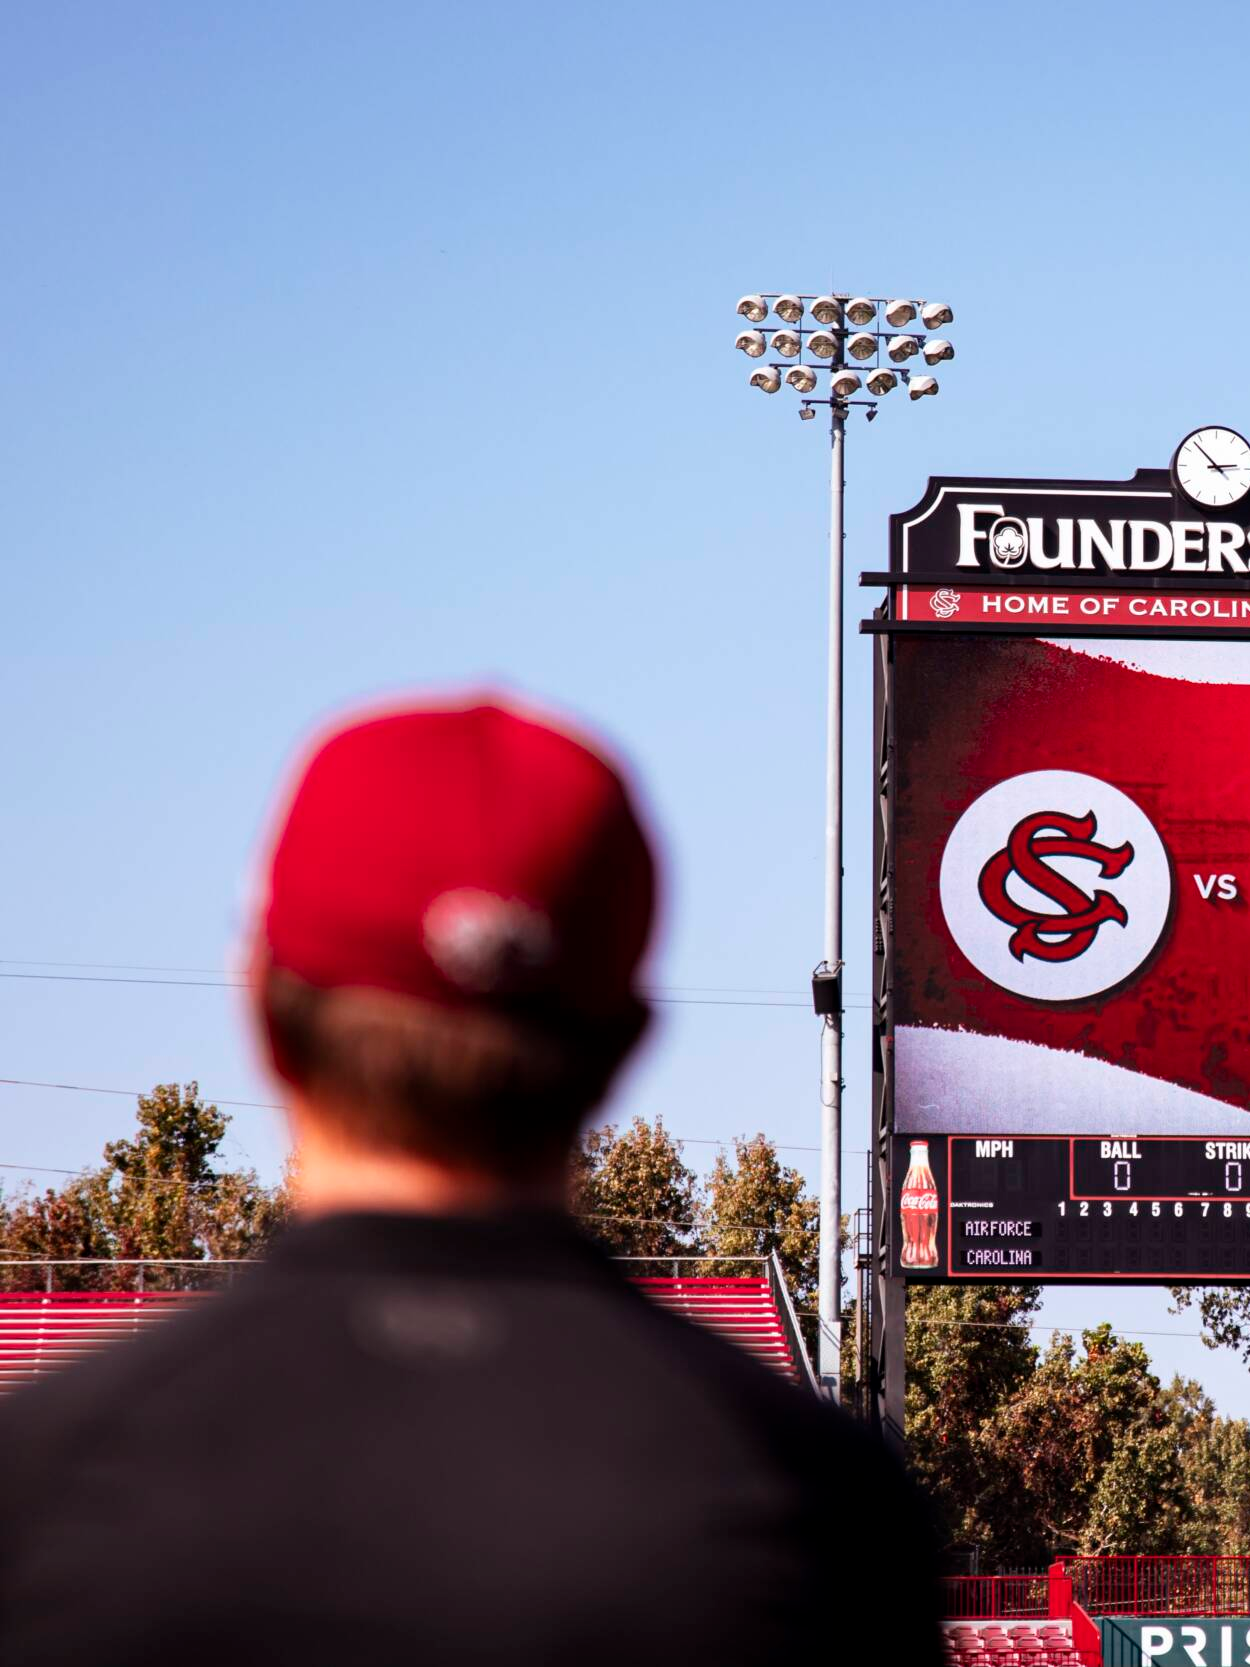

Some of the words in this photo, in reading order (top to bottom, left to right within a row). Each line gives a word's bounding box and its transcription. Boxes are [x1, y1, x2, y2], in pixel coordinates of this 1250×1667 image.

[982, 595, 1070, 615] HOME
[1079, 597, 1120, 615] OF
[1193, 874, 1237, 900] VS
[975, 1140, 1014, 1158] MPH
[1100, 1140, 1142, 1159] BALL
[1114, 1160, 1131, 1191] 0
[1225, 1161, 1242, 1192] 0
[1057, 1201, 1066, 1217] 1
[1079, 1201, 1089, 1217] 2
[1102, 1201, 1113, 1217] 3
[1129, 1201, 1139, 1217] 4
[1151, 1201, 1161, 1217] 5
[1174, 1201, 1184, 1218] 6
[1200, 1201, 1210, 1218] 7
[1223, 1202, 1233, 1218] 8
[967, 1249, 1032, 1265] CAROLINA
